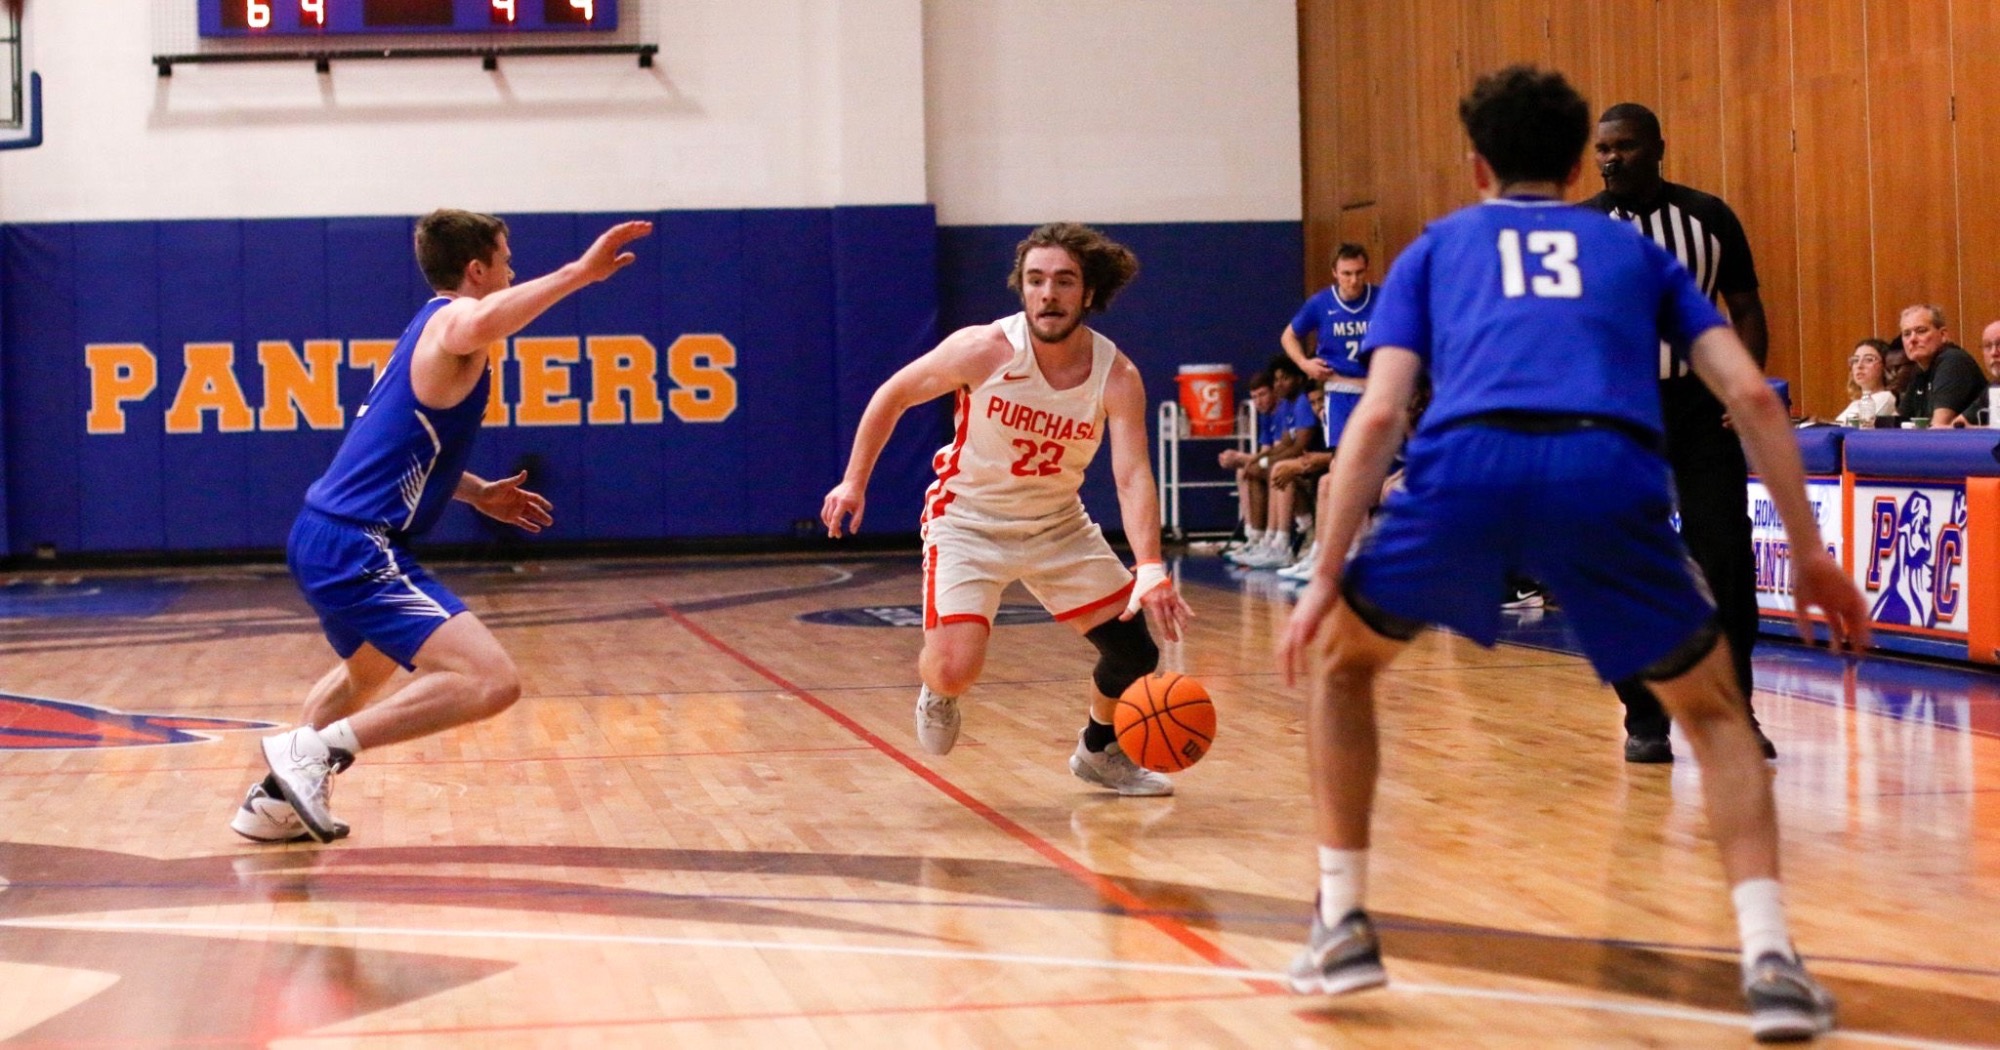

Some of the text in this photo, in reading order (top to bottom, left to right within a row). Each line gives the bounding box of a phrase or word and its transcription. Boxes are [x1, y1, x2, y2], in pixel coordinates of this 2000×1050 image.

[1498, 228, 1583, 299] 13
[1333, 321, 1368, 337] MSM
[1346, 340, 1359, 362] 2
[1010, 438, 1065, 477] 22
[1866, 496, 1899, 592] P
[1933, 523, 1963, 622] C
